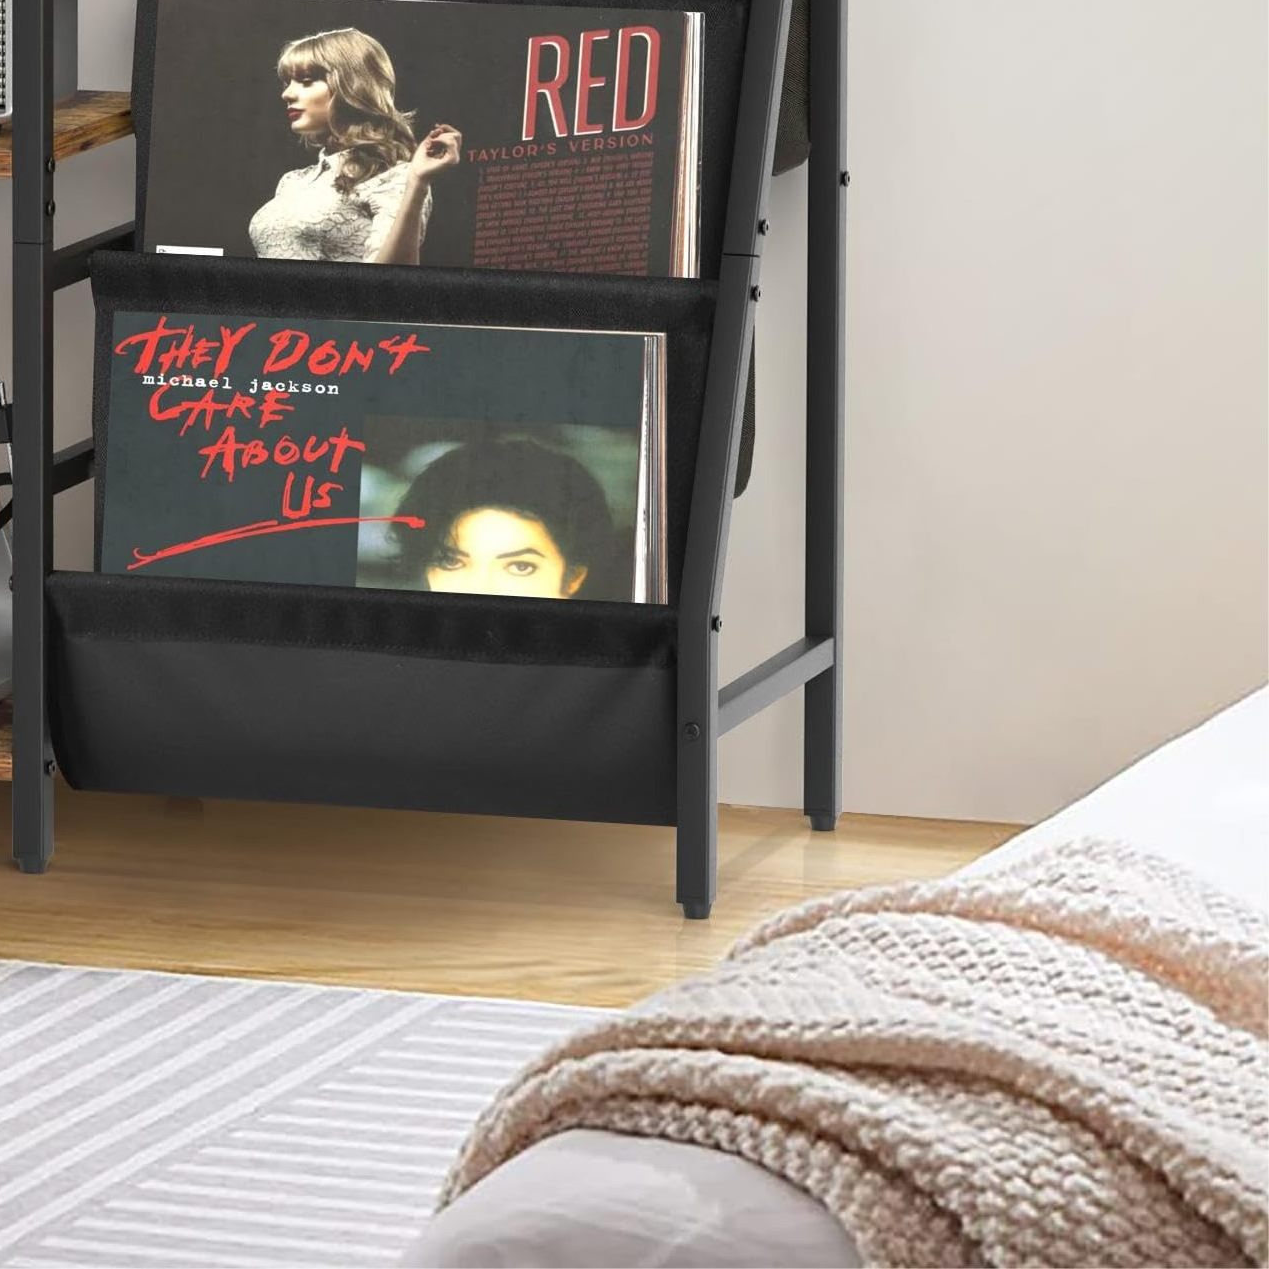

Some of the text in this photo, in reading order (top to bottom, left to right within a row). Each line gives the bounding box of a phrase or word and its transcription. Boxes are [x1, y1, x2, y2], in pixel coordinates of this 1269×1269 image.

[522, 25, 661, 141] RED
[467, 134, 654, 163] TAYLOR'S VERSION
[114, 316, 257, 380] THEY
[141, 373, 340, 395] michael jackson
[148, 377, 295, 436] CARE
[197, 424, 366, 483] ABOUT
[282, 472, 345, 519] US
